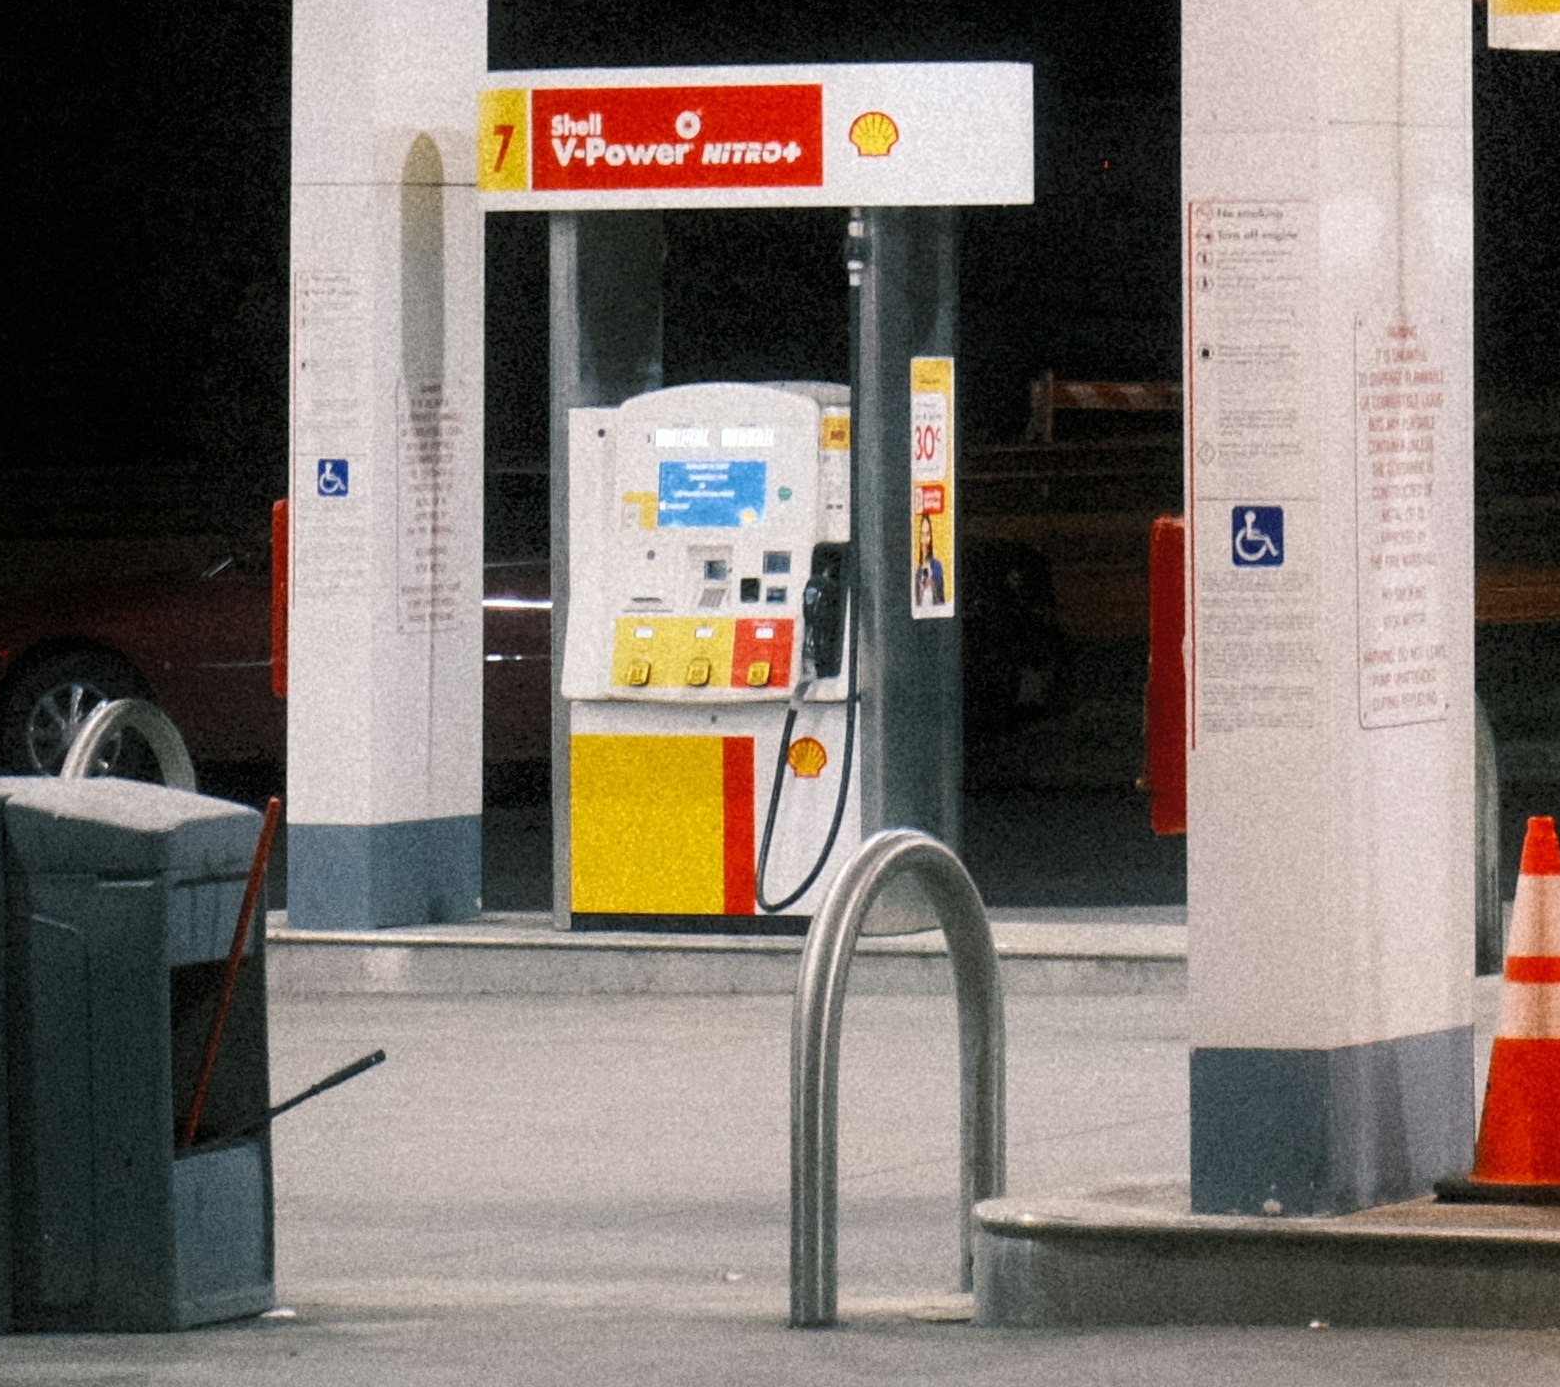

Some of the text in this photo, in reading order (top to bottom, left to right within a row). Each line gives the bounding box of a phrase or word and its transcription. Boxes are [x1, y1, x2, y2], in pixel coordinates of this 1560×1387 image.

[551, 113, 602, 137] Shell
[493, 124, 515, 172] 7
[553, 138, 802, 167] V-Power NITRO+
